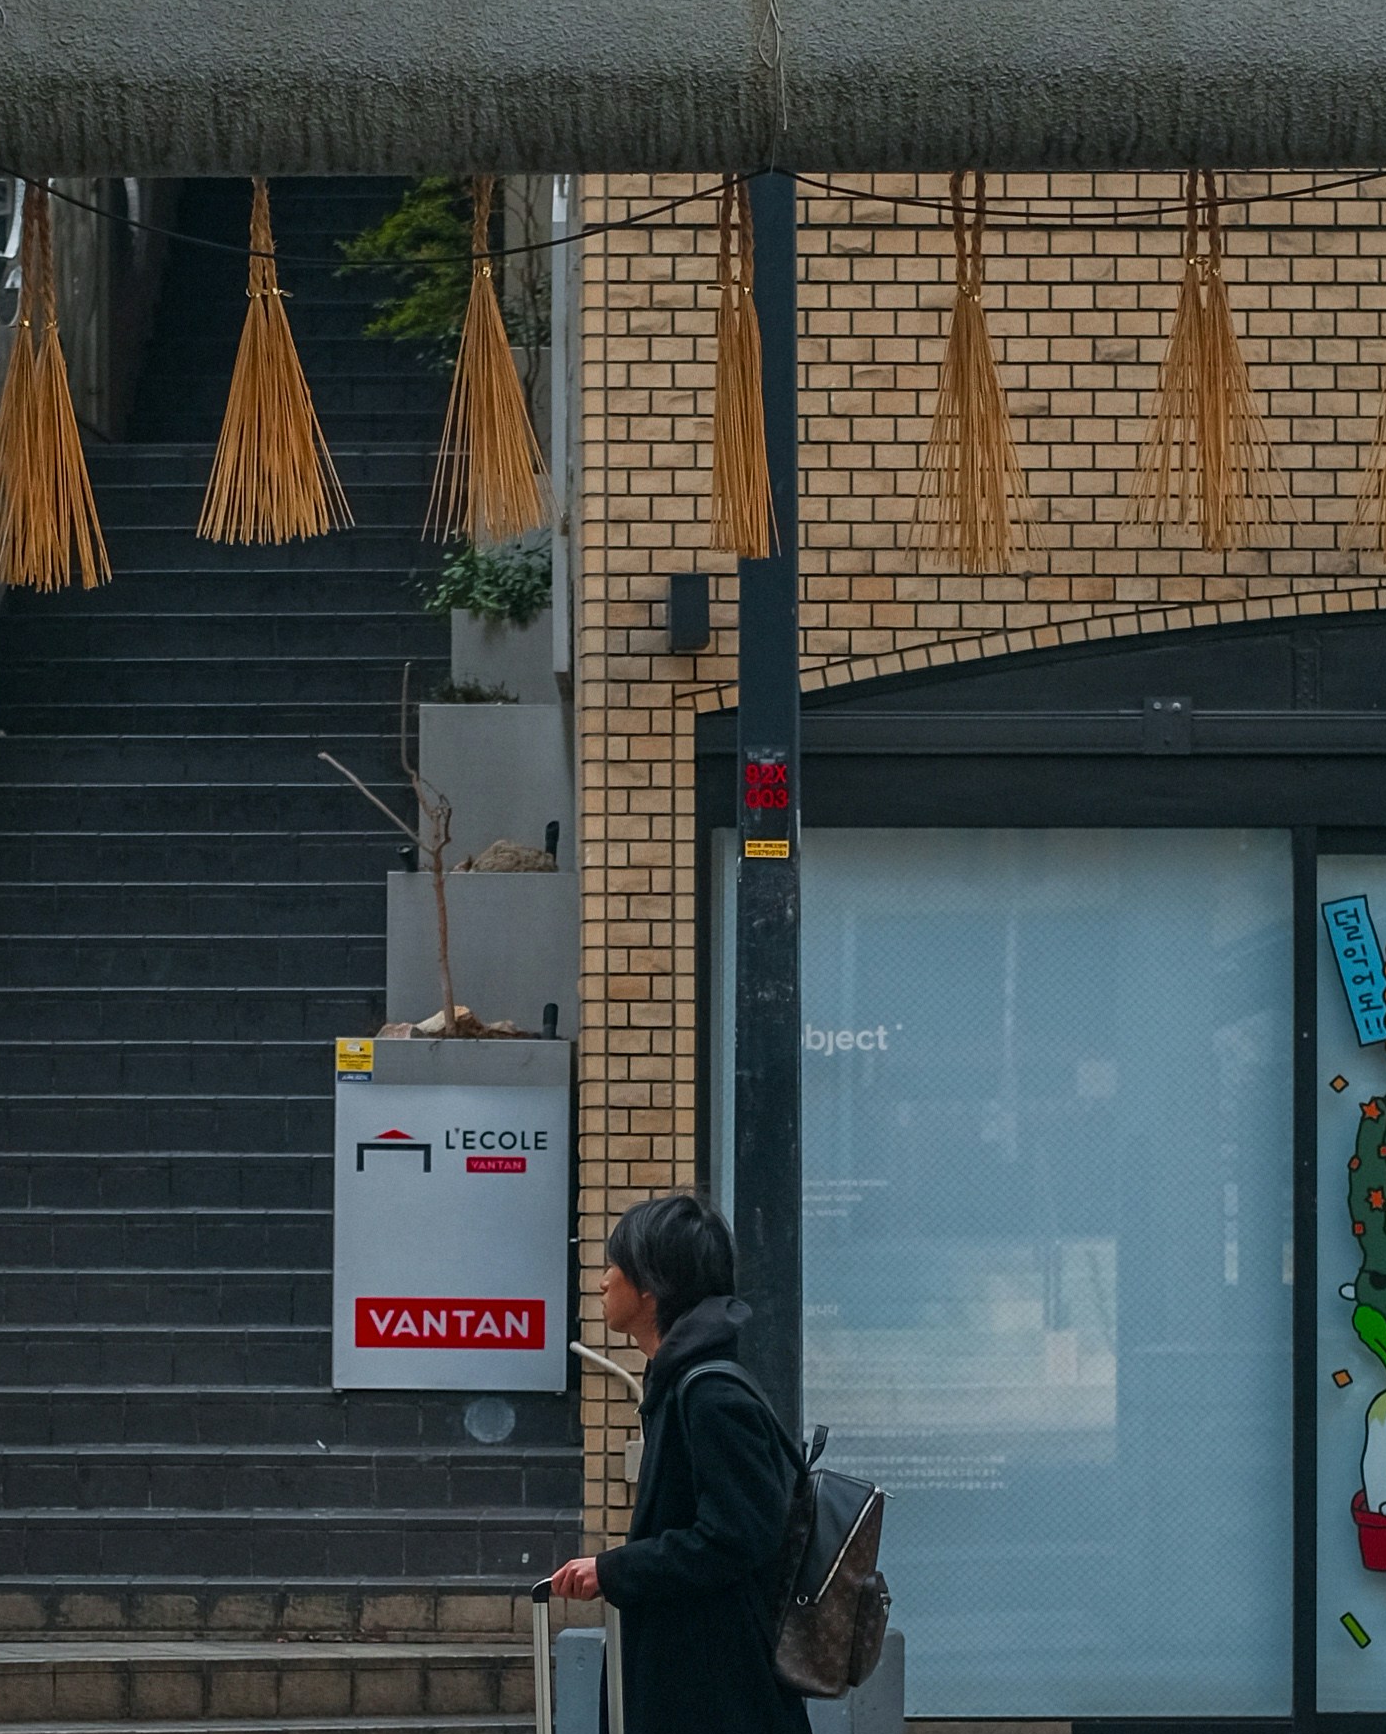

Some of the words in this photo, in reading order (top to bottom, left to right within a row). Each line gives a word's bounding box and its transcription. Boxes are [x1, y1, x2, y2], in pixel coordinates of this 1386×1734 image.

[800, 1023, 889, 1058] bject
[470, 1160, 523, 1172] VANTAN
[368, 1308, 531, 1339] VANTAN
